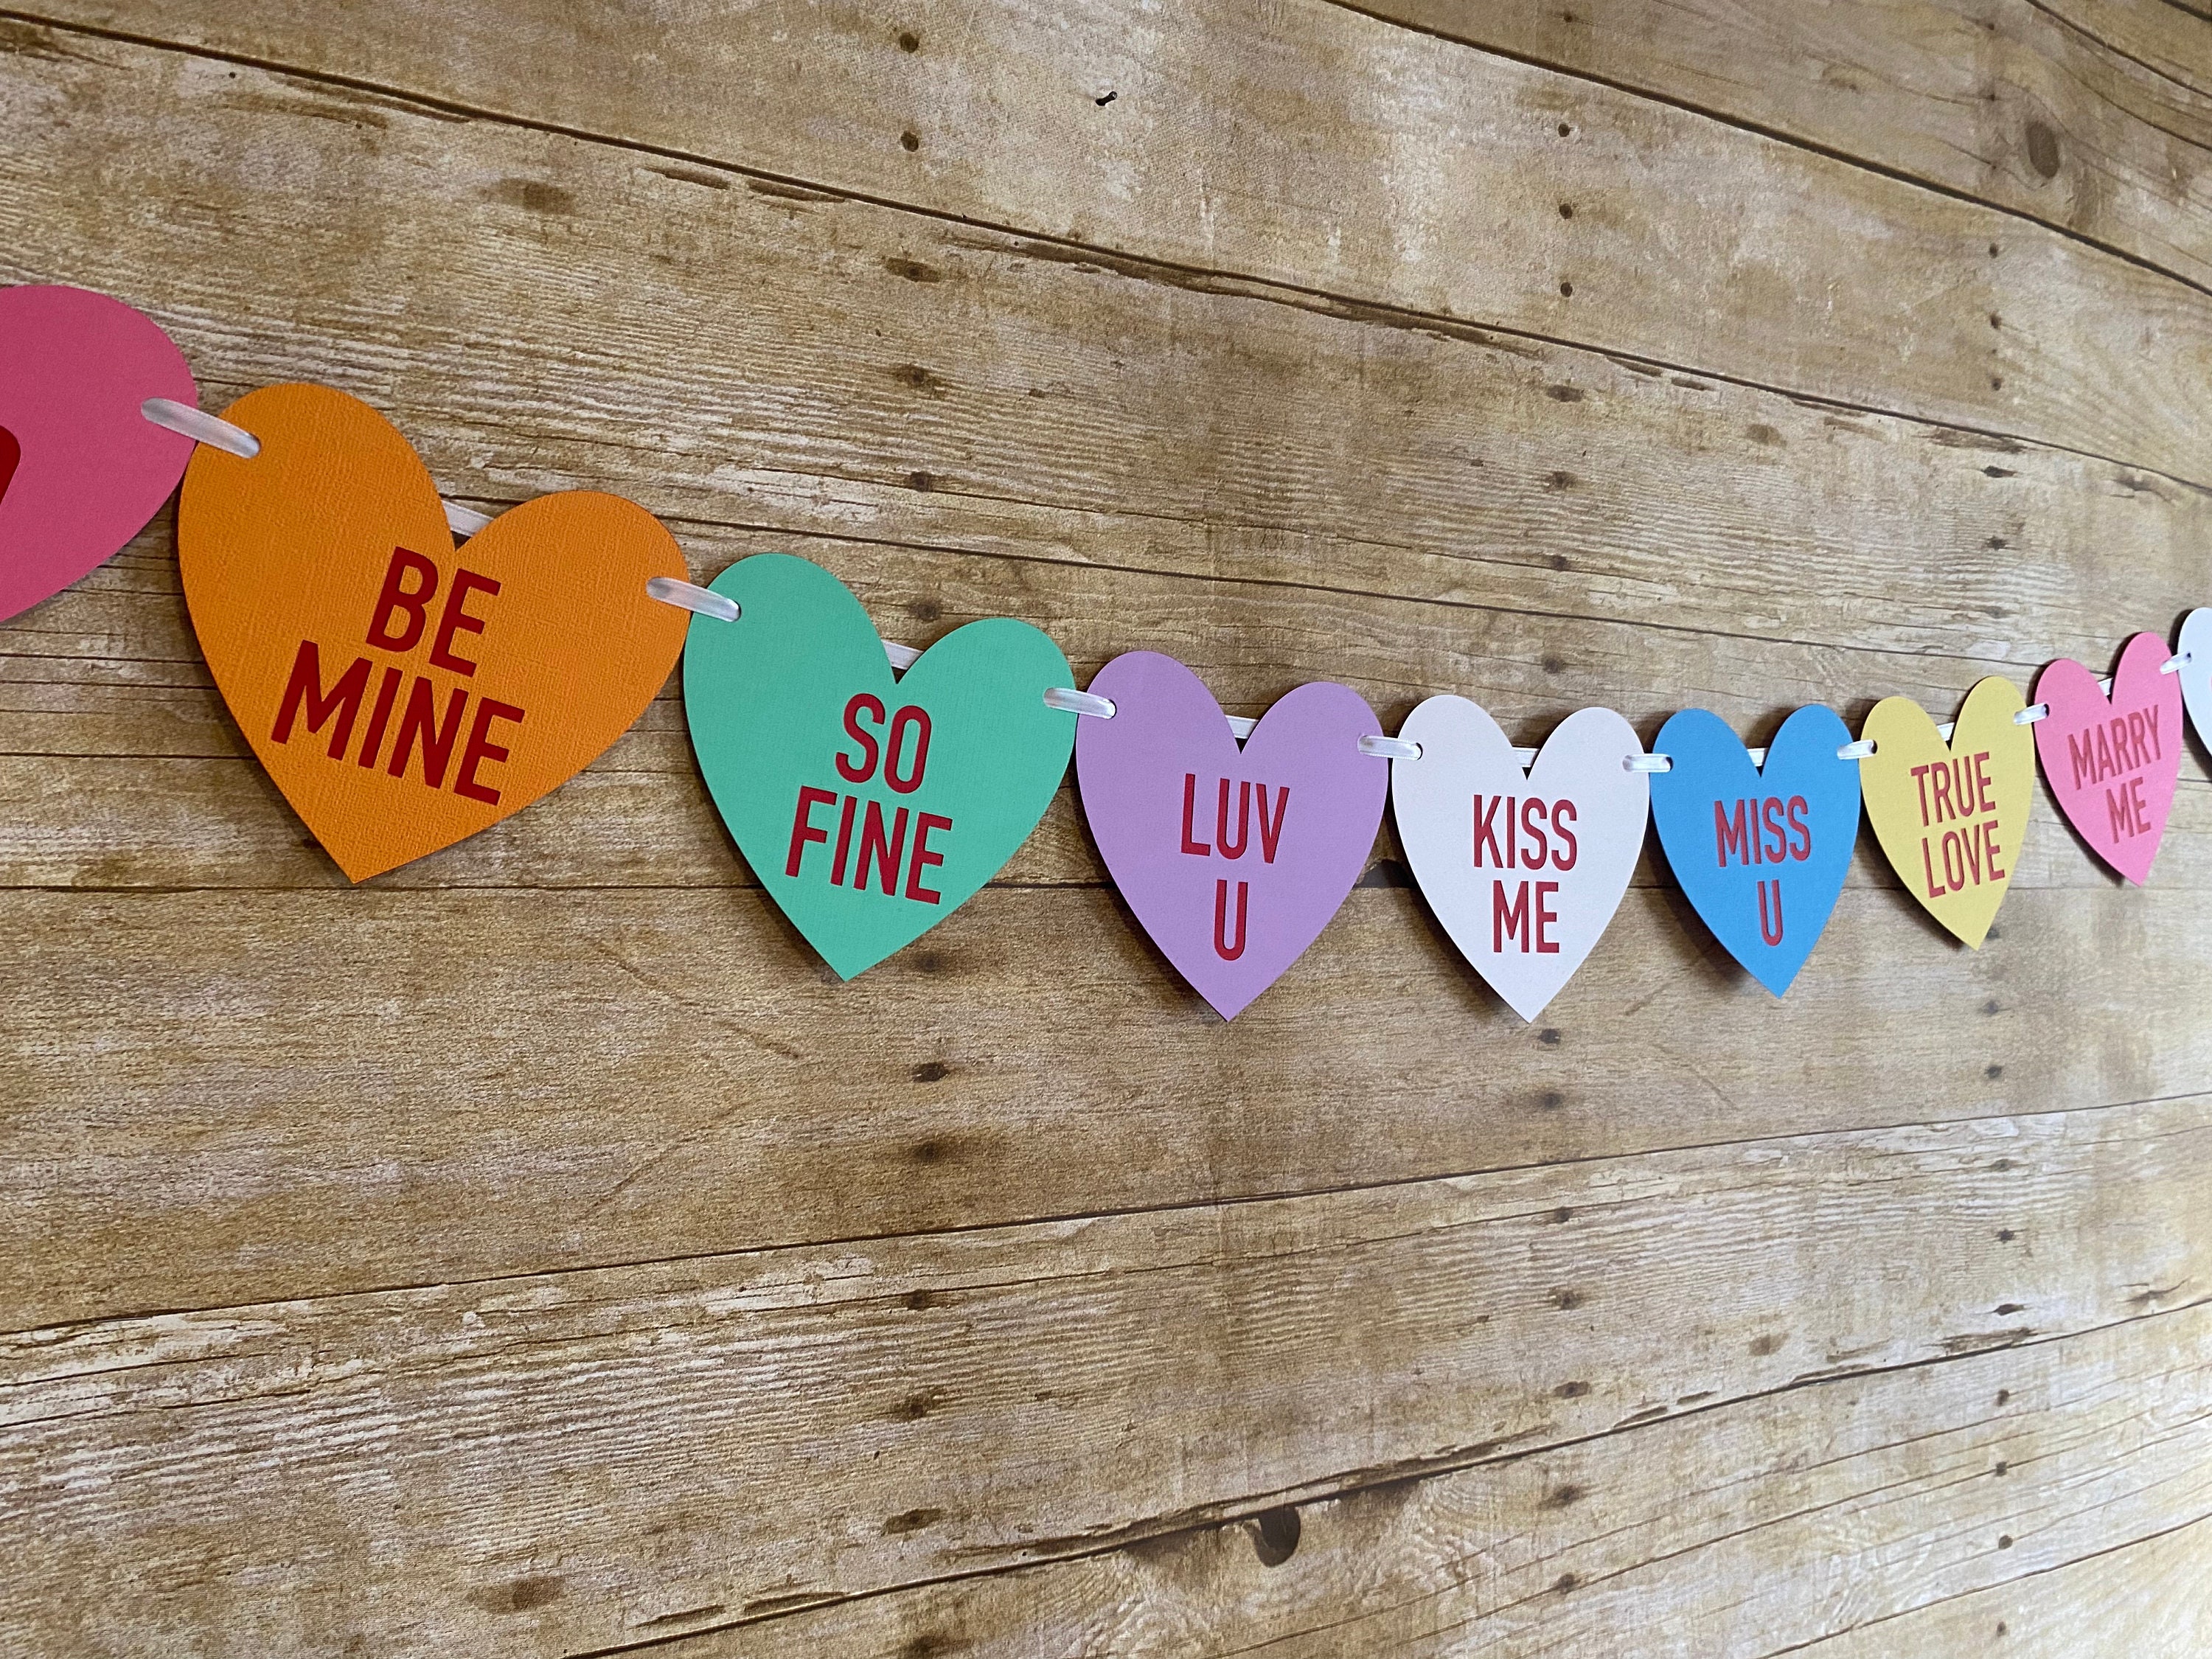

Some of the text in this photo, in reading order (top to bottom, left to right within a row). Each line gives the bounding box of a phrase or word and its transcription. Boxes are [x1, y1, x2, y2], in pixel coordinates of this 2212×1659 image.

[366, 546, 501, 678] BE
[271, 639, 526, 806] MINE
[835, 694, 931, 793] SO
[2067, 705, 2163, 790] MARRY
[1181, 773, 1290, 865] LUV
[1910, 752, 1996, 827] TRUE
[2105, 776, 2152, 844] ME
[785, 786, 953, 904] FINE
[1474, 795, 1578, 872] KISS
[1715, 796, 1811, 867] MISS
[1921, 821, 2006, 898] LOVE
[1214, 880, 1248, 961] U
[1493, 880, 1560, 954] ME
[1756, 879, 1783, 947] U
